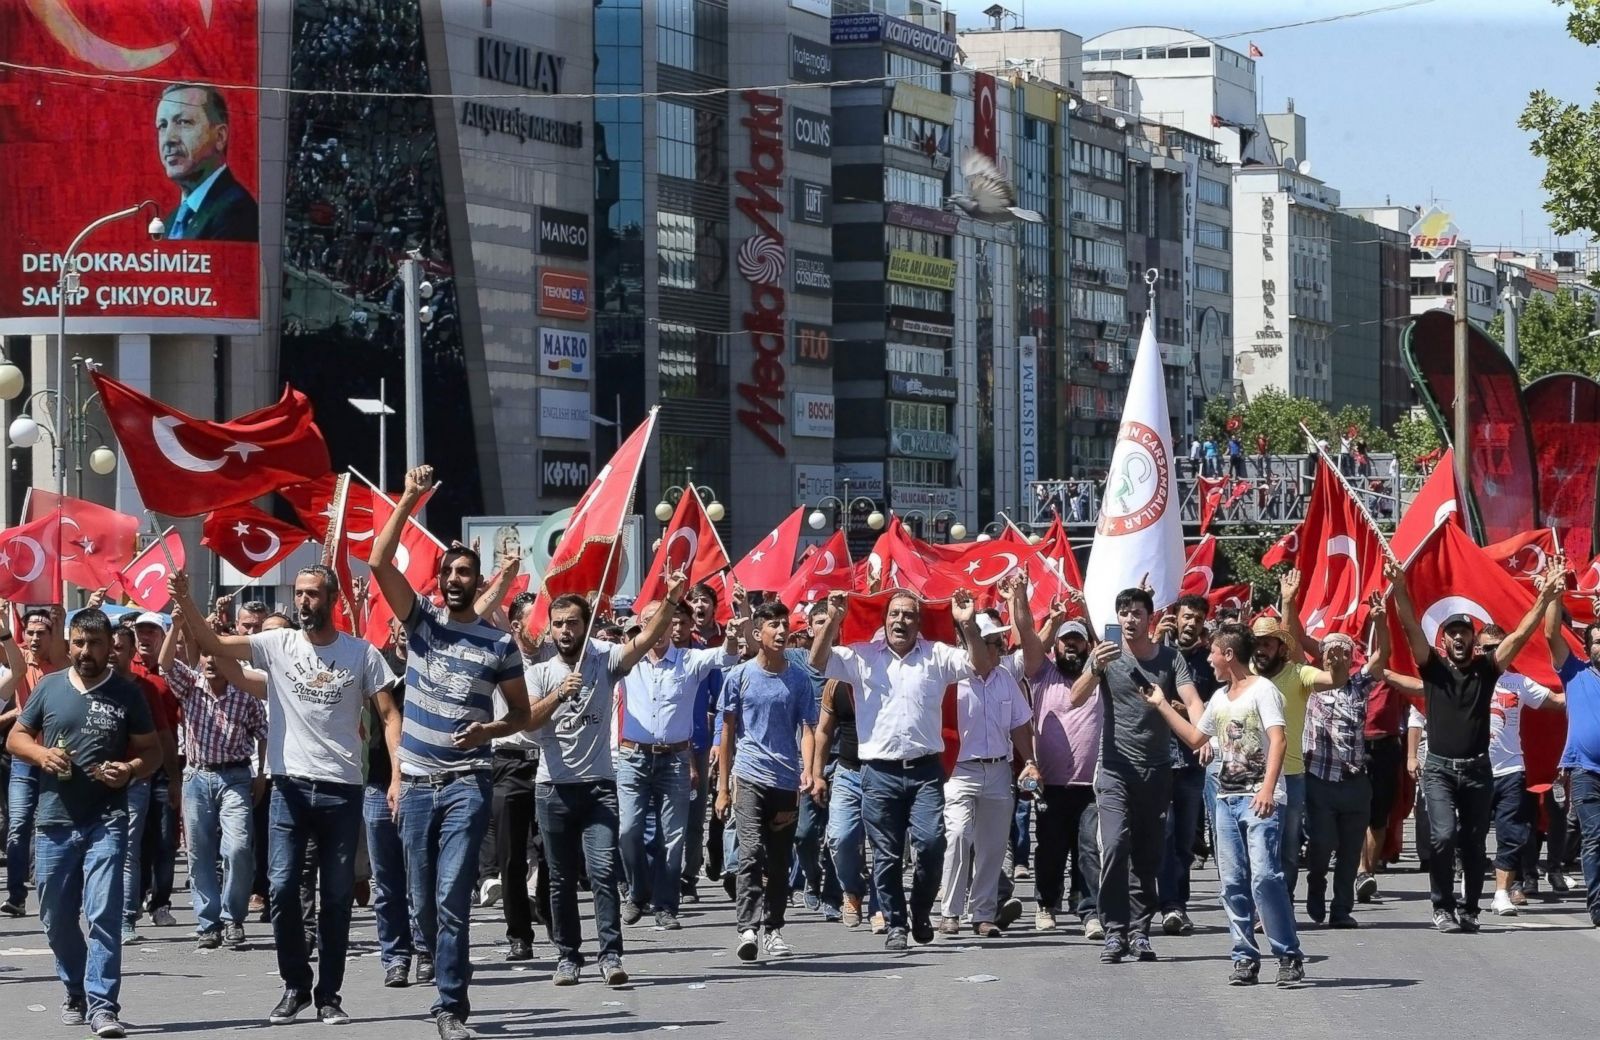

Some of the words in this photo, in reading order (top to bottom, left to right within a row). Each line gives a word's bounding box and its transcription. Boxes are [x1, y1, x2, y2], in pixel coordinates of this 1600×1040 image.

[478, 37, 566, 94] KIZILAY
[794, 46, 831, 74] hatemoğlu
[796, 118, 830, 147] COLIN'S
[541, 221, 587, 247] MANGO
[1413, 234, 1458, 247] final
[22, 249, 212, 273] DEMOKRASİMİZE
[795, 270, 831, 289] COSMETICS
[96, 285, 218, 309] ÇIKIYORUZ.
[544, 333, 588, 358] MAKRO
[800, 327, 829, 360] FLO
[808, 401, 834, 420] BOSCH
[1022, 364, 1035, 438] SİSTEM
[292, 682, 344, 705] Strength
